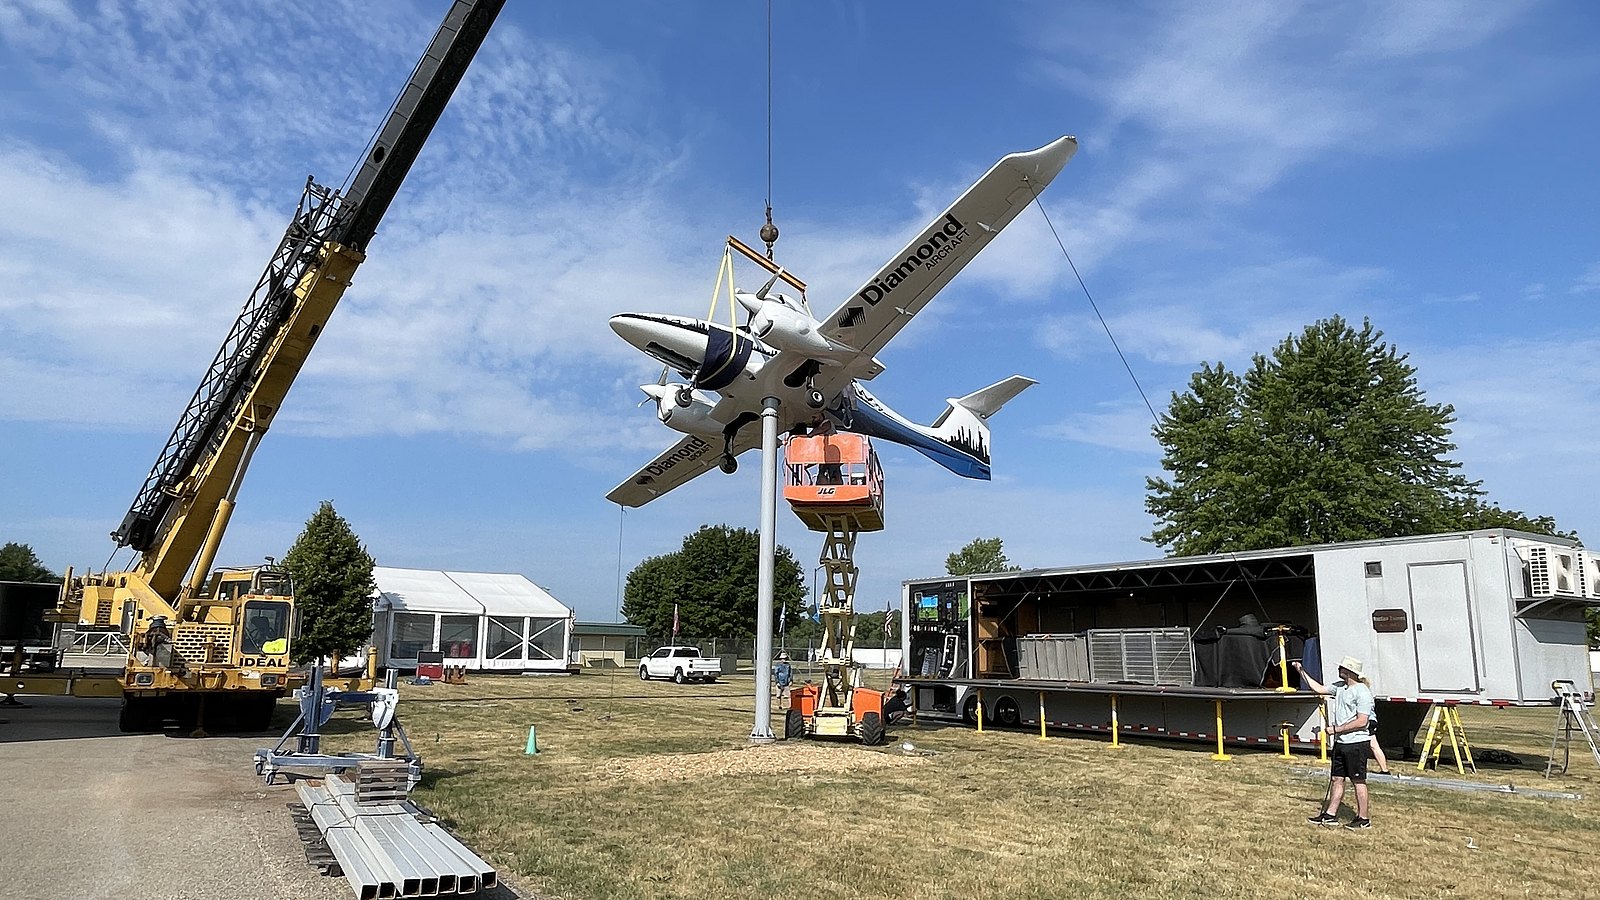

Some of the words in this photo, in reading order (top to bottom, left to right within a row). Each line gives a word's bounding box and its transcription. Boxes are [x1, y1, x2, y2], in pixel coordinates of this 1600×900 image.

[859, 213, 964, 306] Diamond
[925, 228, 970, 271] AIRCRAFT
[647, 435, 706, 476] Diamond
[240, 657, 286, 667] IDEAL
